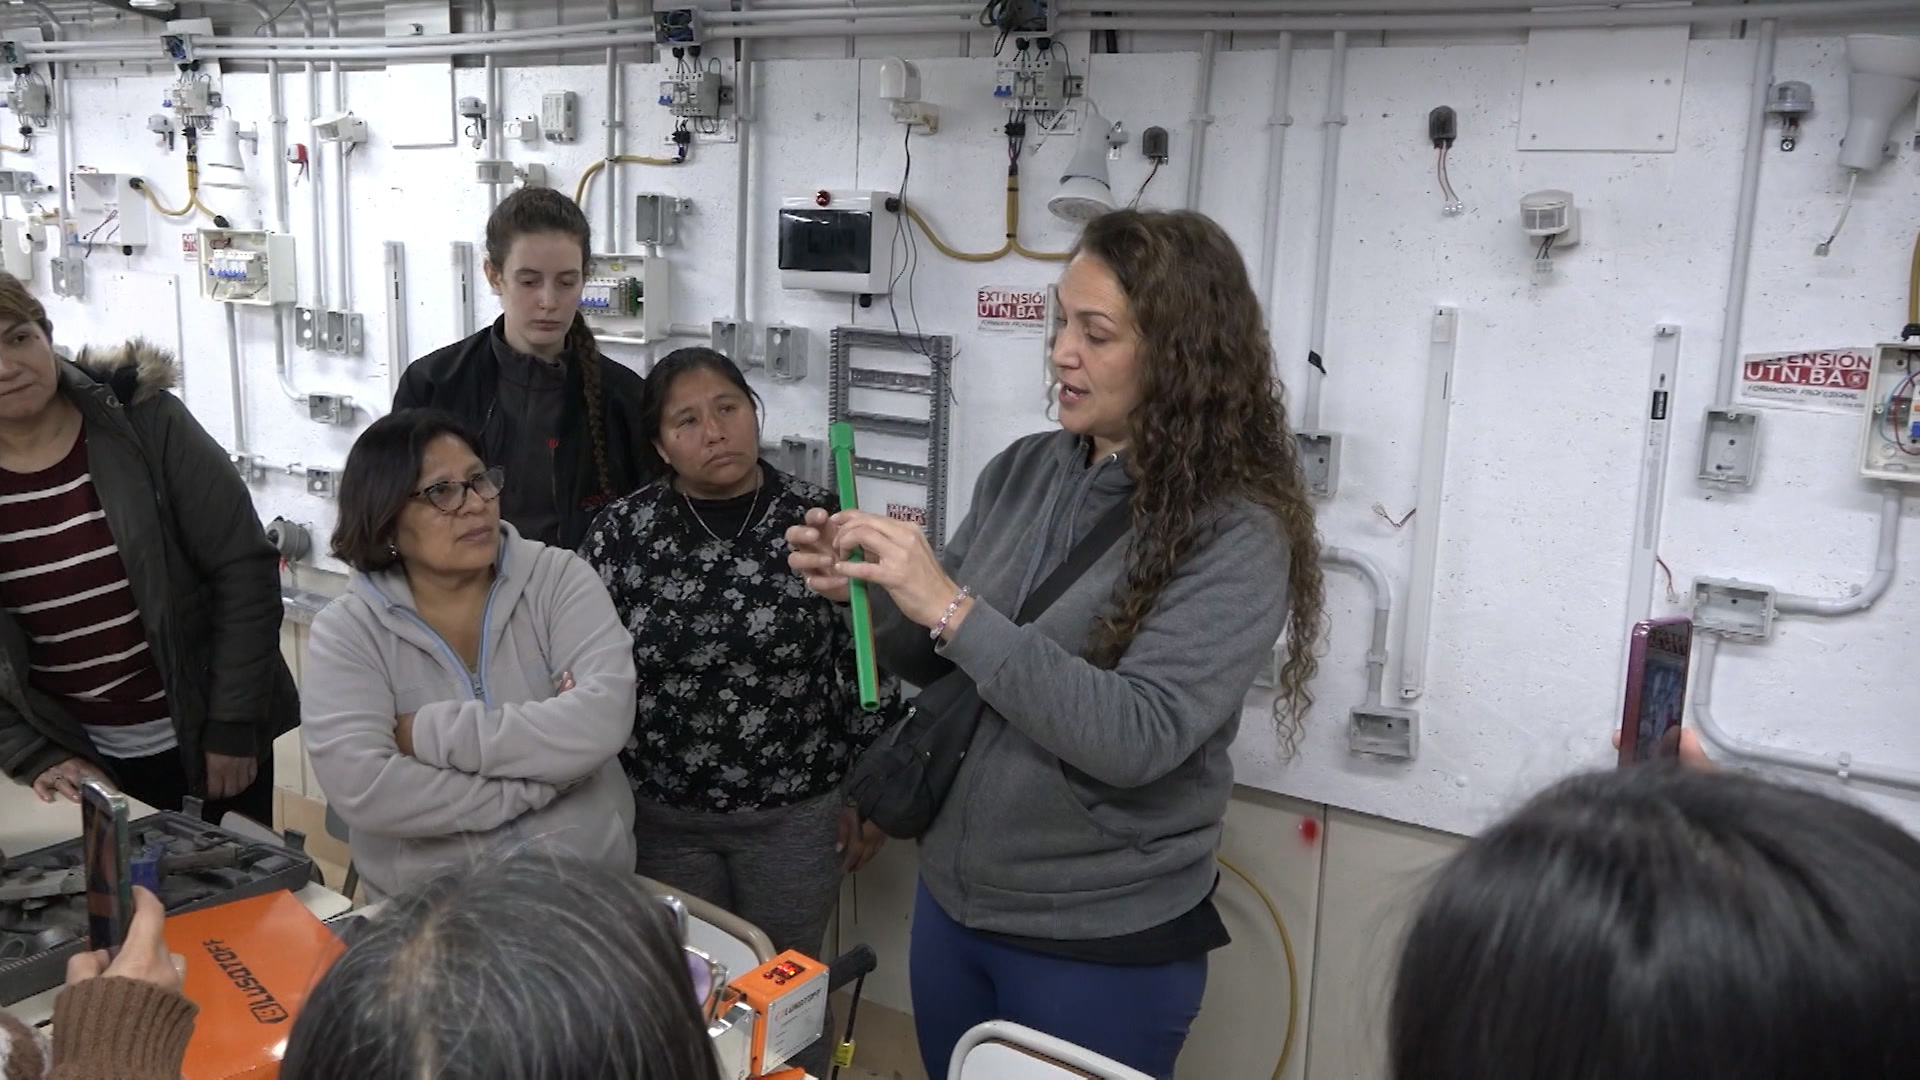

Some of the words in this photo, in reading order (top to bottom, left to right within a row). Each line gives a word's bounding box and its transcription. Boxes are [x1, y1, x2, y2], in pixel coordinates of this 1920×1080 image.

[979, 304, 1038, 318] UTN.BA
[1766, 351, 1872, 370] ENSIÓN
[1746, 364, 1846, 386] UTN.BA
